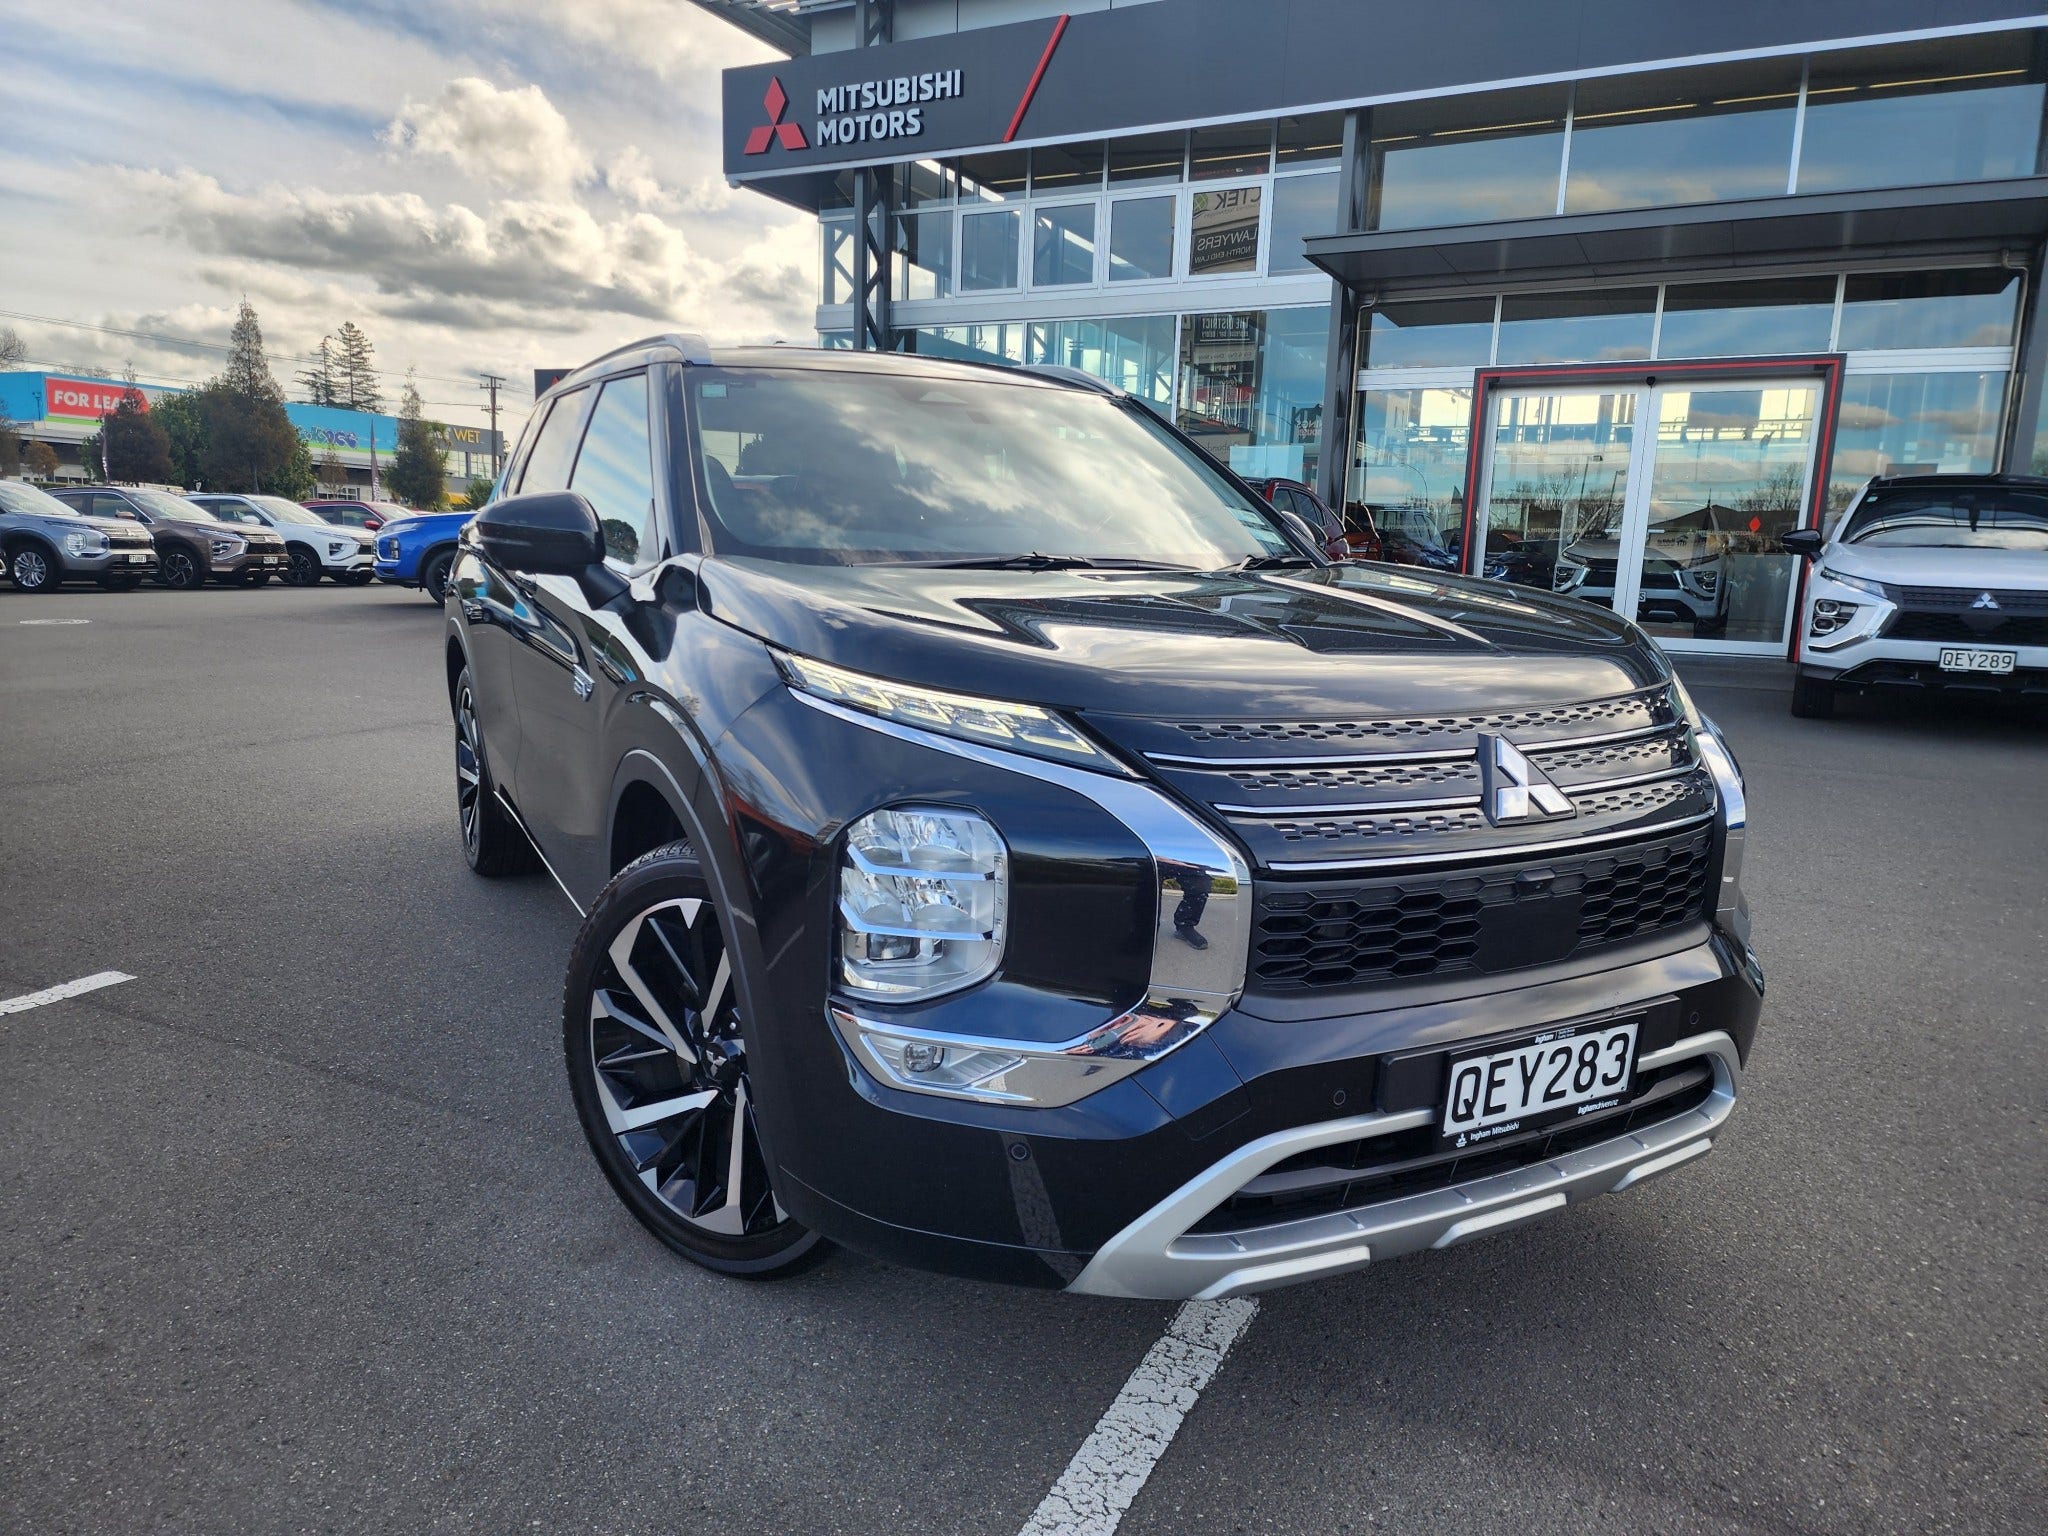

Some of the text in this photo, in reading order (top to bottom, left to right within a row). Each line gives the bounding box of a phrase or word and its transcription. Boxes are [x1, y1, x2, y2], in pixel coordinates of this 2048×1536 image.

[817, 69, 961, 115] MITSUBISHI
[817, 108, 921, 146] MOTORS
[54, 390, 126, 410] FOR LEA
[453, 427, 480, 443] WET
[1943, 652, 2012, 669] QEY289
[1452, 1032, 1630, 1123] QEY283
[1470, 1121, 1520, 1142] Ingham Mitsubishi
